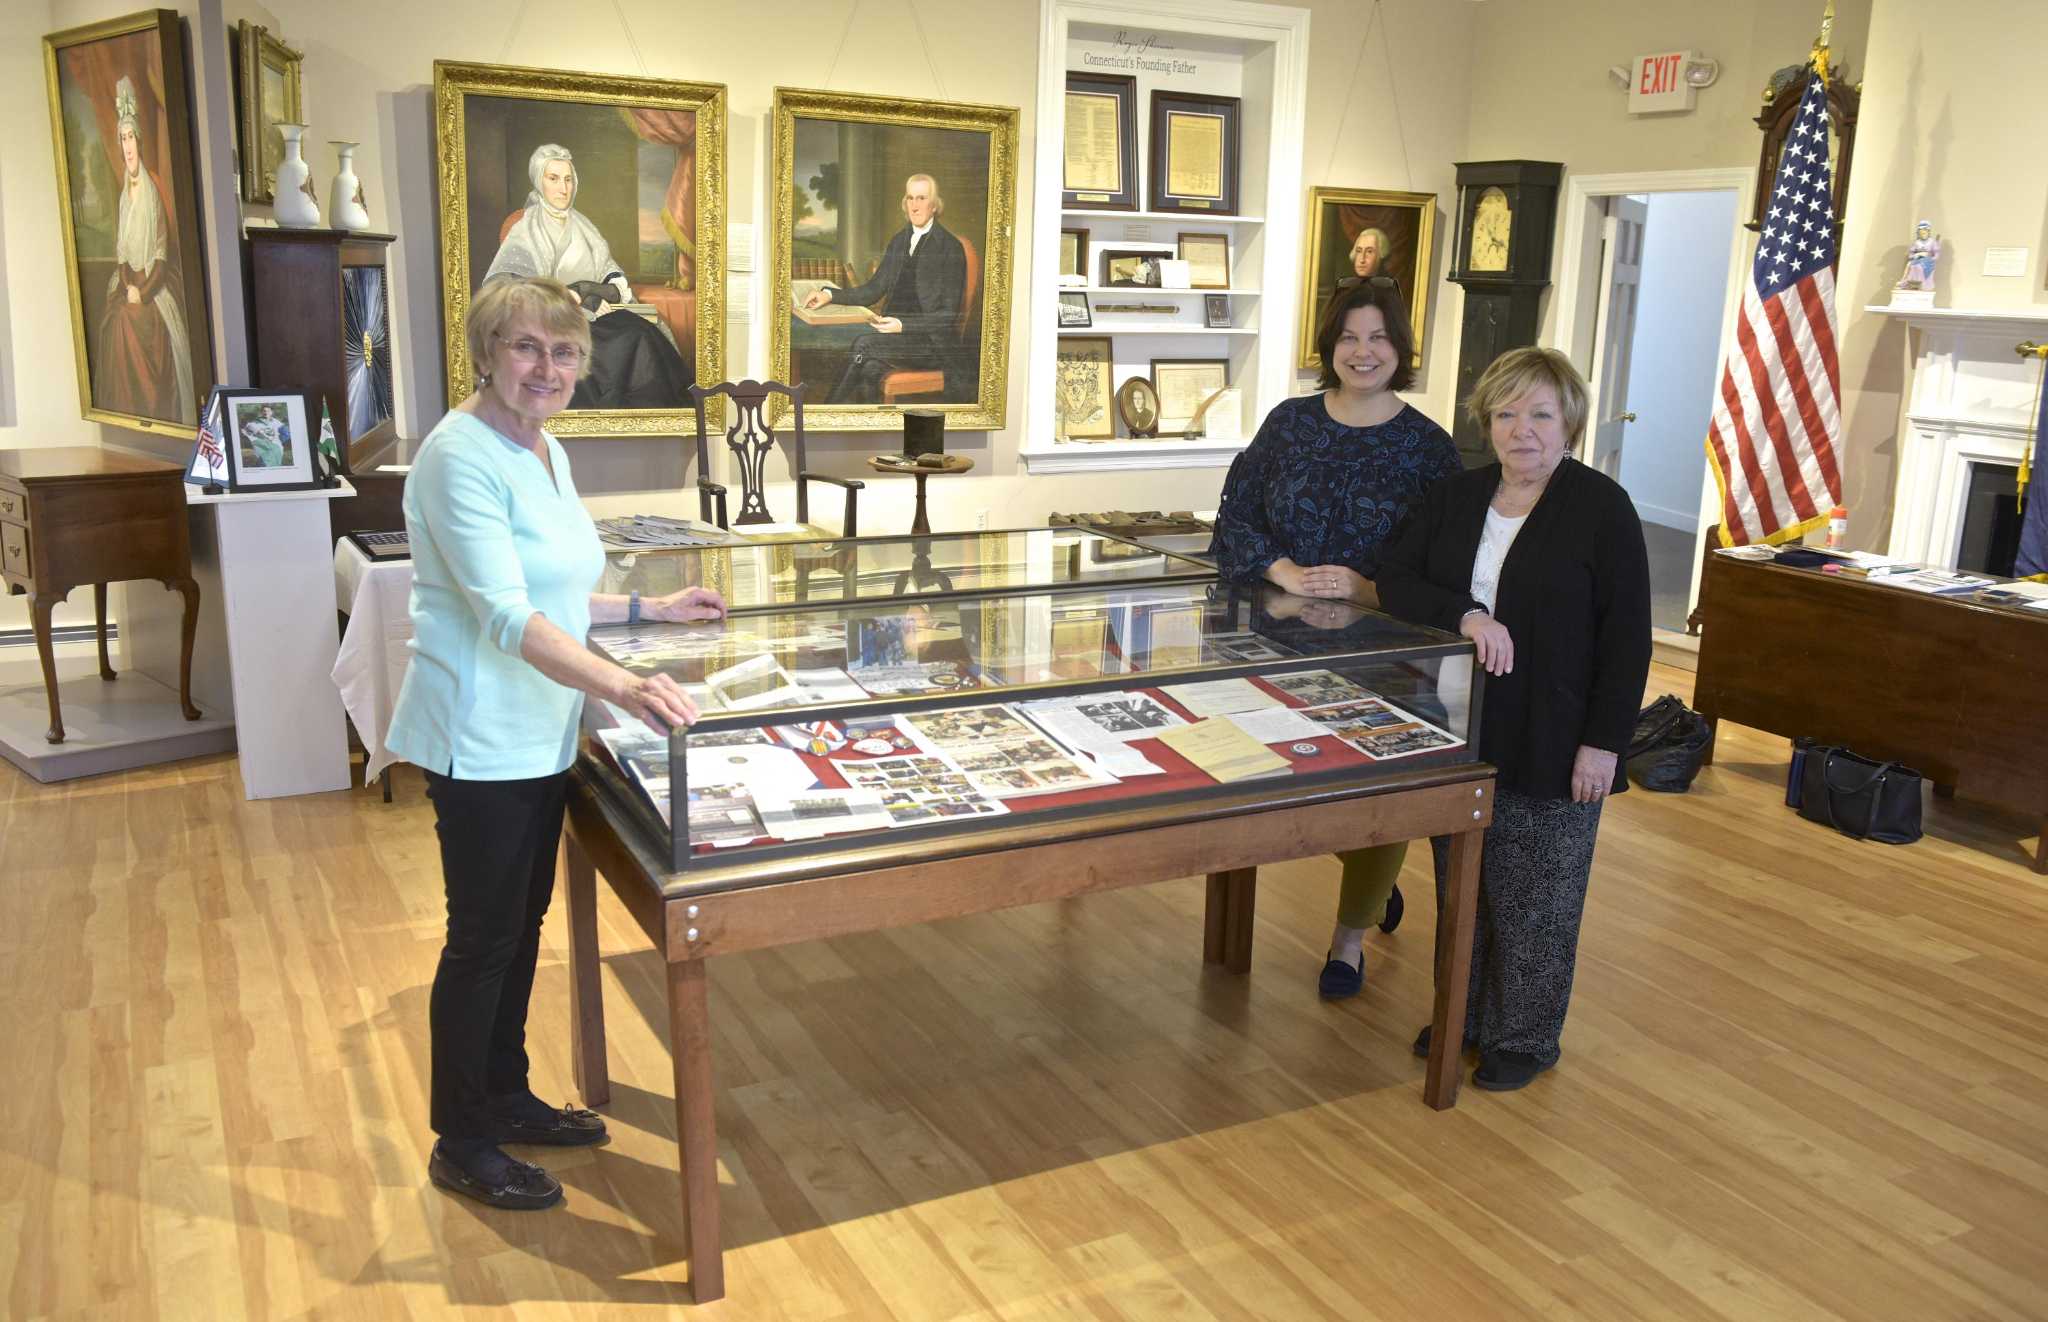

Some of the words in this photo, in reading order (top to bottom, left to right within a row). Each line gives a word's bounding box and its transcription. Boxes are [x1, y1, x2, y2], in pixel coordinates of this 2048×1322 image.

[1083, 51, 1134, 69] Connecticut's
[1136, 56, 1171, 75] Founding
[1173, 60, 1197, 75] Father
[1640, 55, 1681, 94] EXIT
